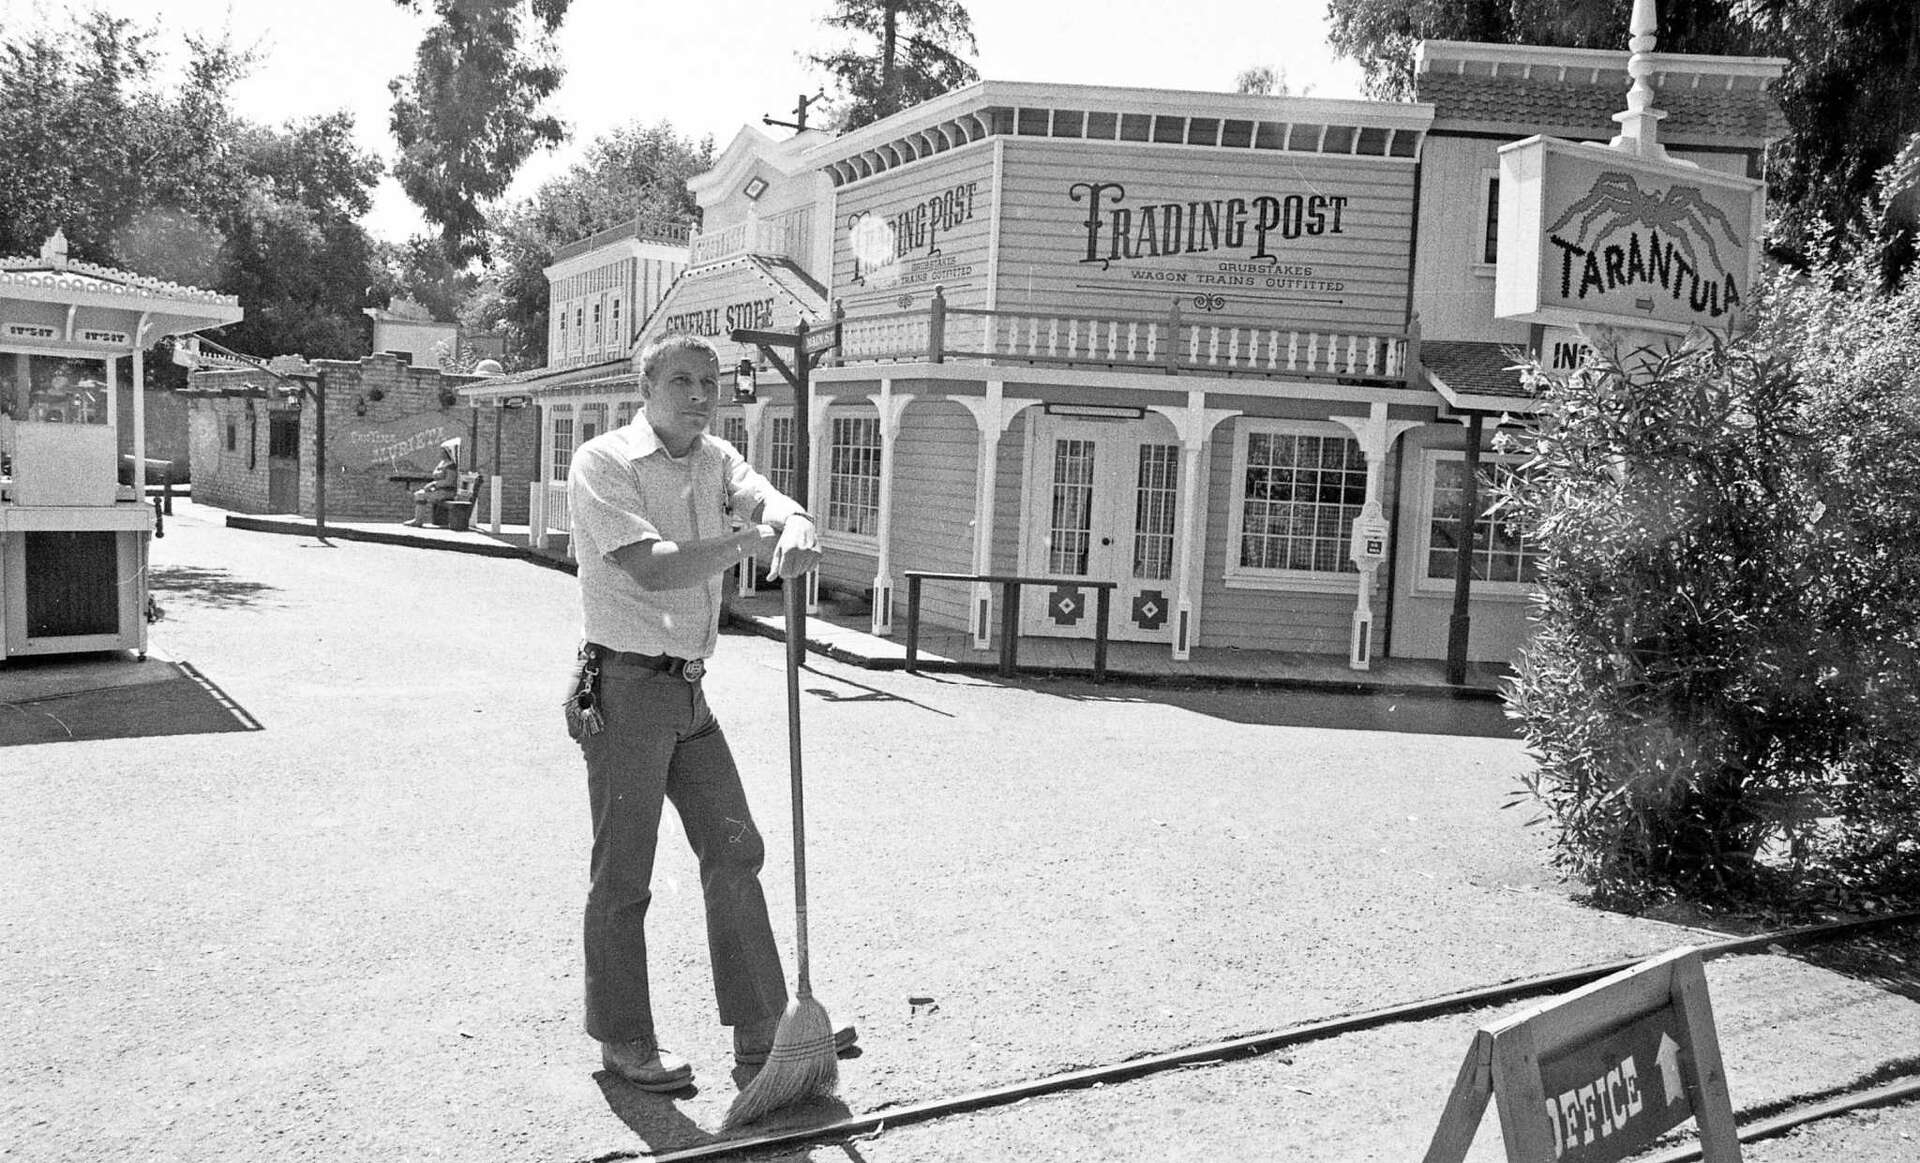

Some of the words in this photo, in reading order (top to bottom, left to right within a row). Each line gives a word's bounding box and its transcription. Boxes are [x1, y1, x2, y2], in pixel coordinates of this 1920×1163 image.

[928, 182, 977, 258] POST
[1069, 182, 1248, 271] TRADING
[1251, 194, 1348, 265] POST
[1131, 270, 1187, 283] WAGON
[1196, 274, 1255, 287] TRAINS
[1265, 278, 1345, 292] OUTFITTED
[1218, 262, 1313, 277] GRUBSTAKES
[1549, 230, 1740, 317] TARANTULA
[666, 308, 721, 337] GENERAL
[725, 298, 775, 336] STORE
